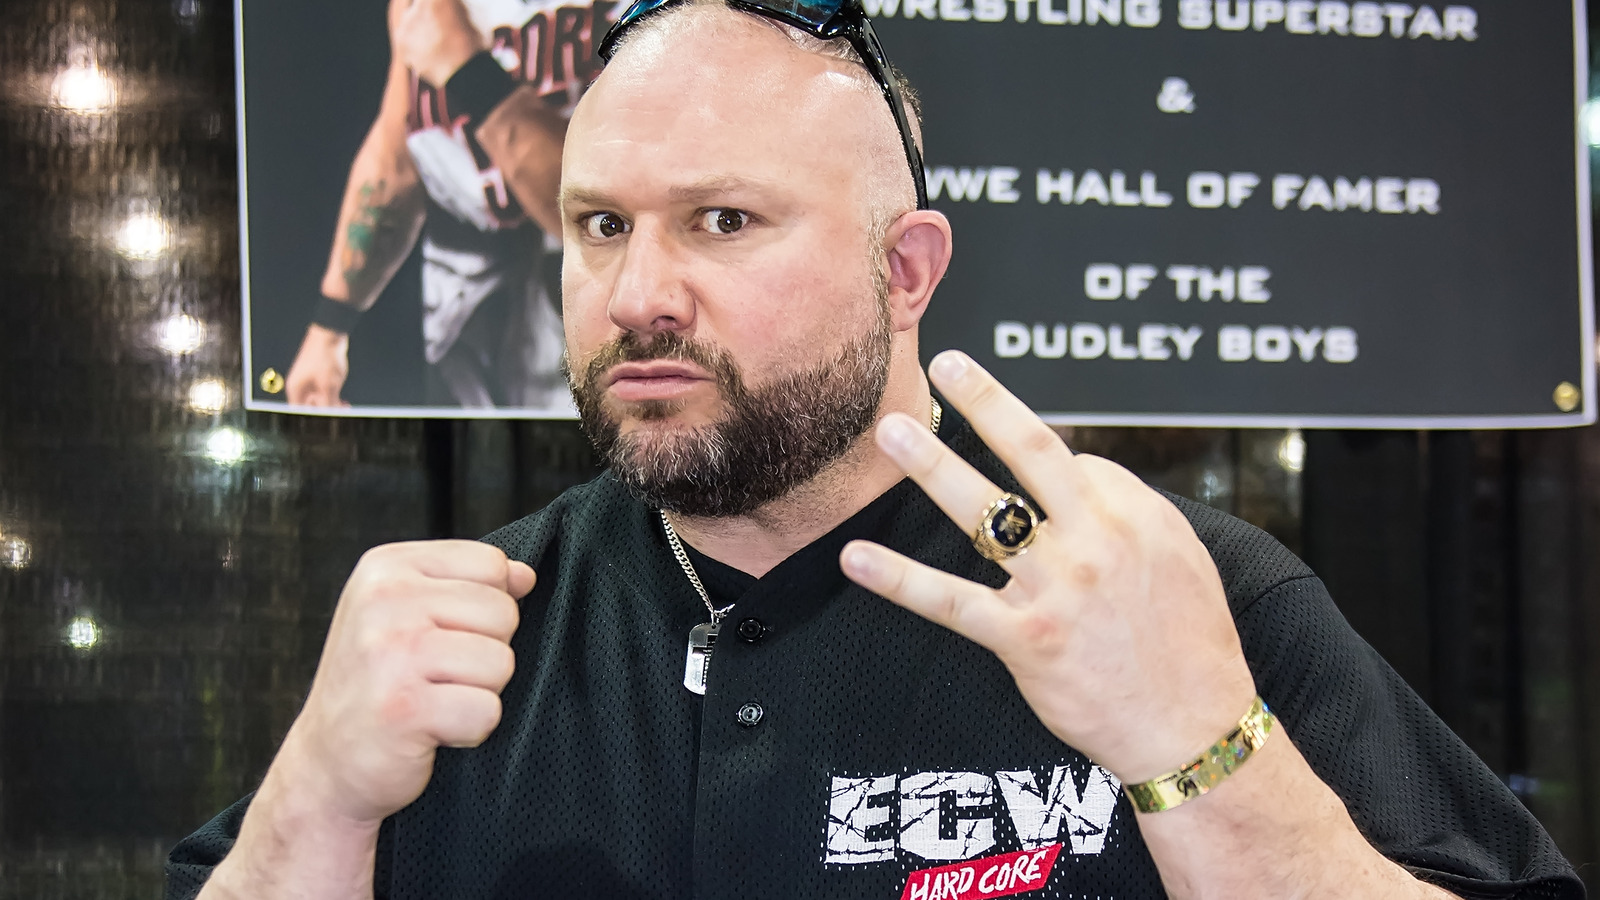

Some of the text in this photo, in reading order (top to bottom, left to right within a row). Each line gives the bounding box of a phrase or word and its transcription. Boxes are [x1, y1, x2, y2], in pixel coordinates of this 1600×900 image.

[1178, 0, 1478, 41] SUPERSTAR
[1157, 77, 1195, 113] &
[1036, 168, 1173, 208] HALL
[1186, 171, 1260, 209] OF
[1272, 174, 1440, 214] FAMER
[1084, 263, 1271, 303] OF THE
[994, 321, 1358, 364] DUDLEY BOYS
[824, 765, 1121, 864] ECW
[909, 850, 1047, 900] HARD CORE
